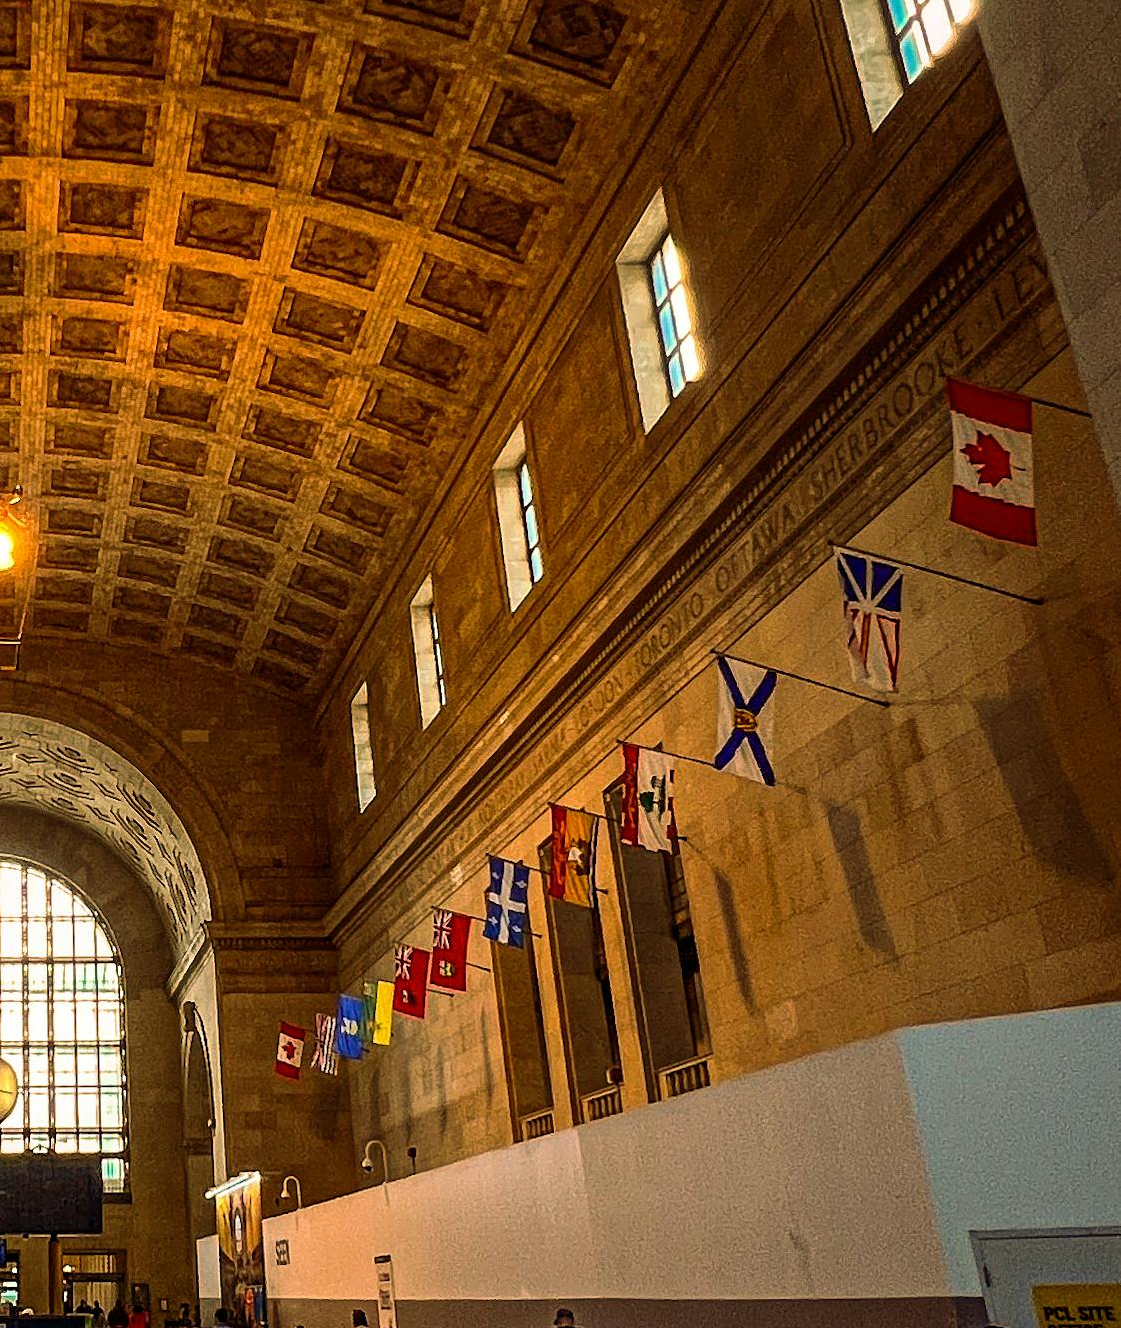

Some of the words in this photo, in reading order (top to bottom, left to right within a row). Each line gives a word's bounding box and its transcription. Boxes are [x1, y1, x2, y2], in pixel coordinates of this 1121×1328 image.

[715, 503, 797, 592] OTTAWA
[810, 323, 975, 500] SHERBROOKE
[1043, 1306, 1076, 1321] PCL
[1078, 1306, 1116, 1321] SITE
